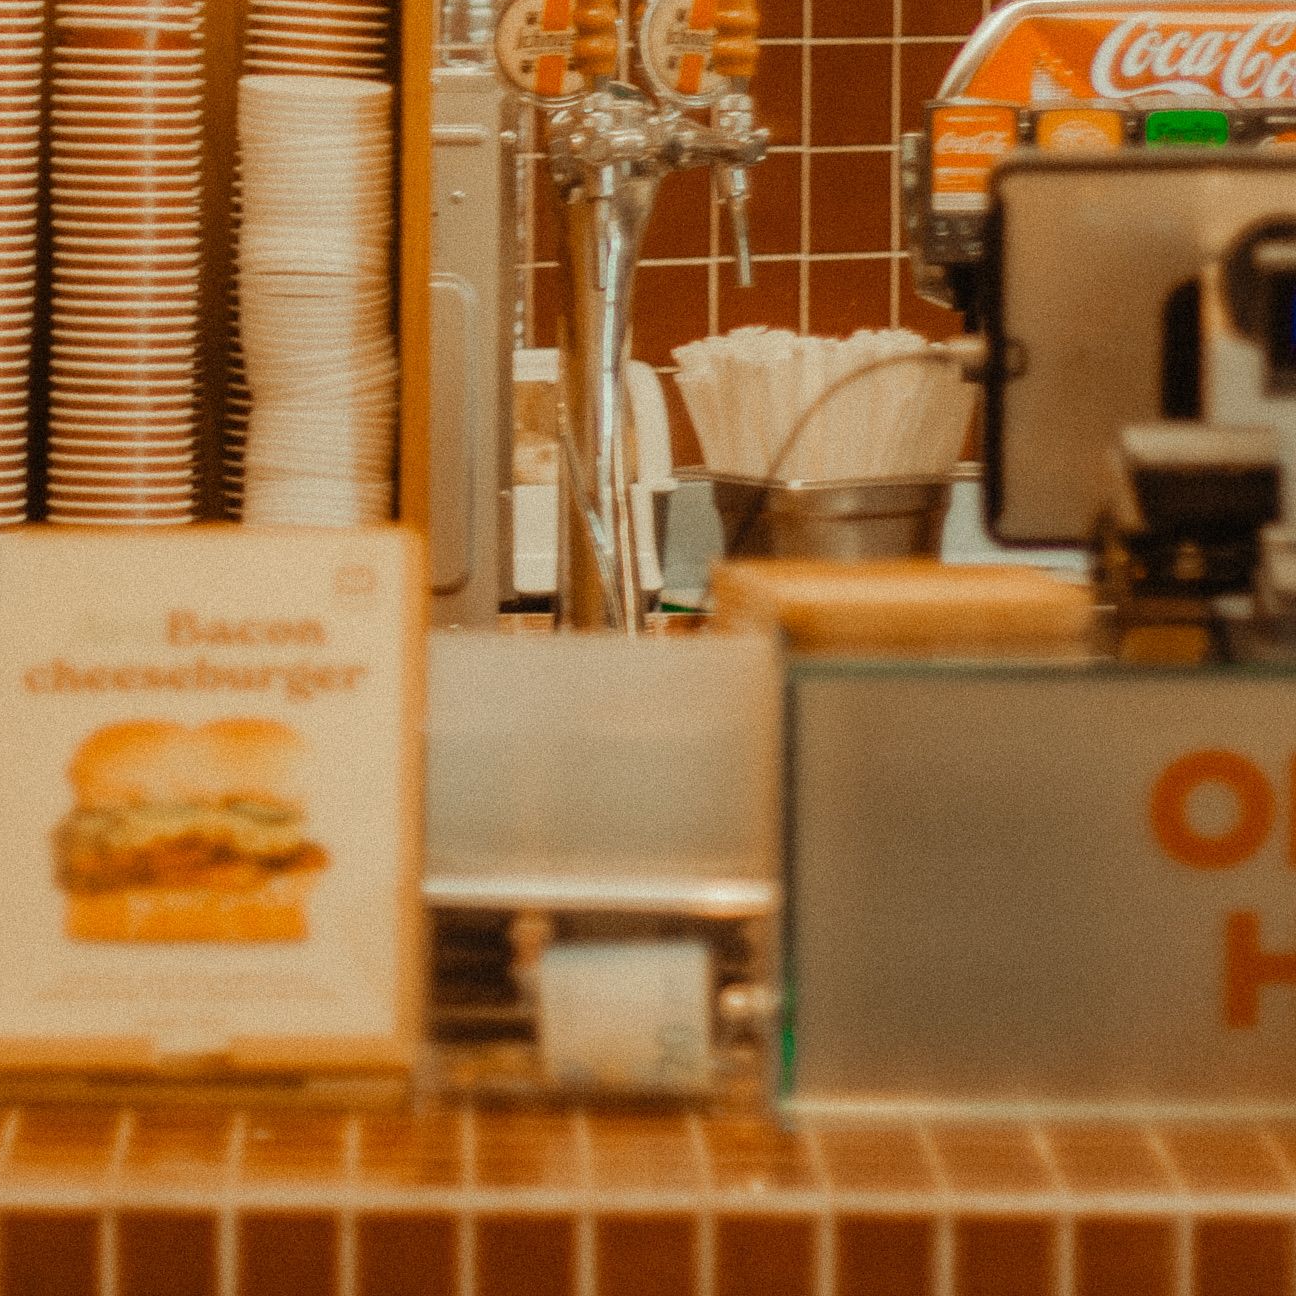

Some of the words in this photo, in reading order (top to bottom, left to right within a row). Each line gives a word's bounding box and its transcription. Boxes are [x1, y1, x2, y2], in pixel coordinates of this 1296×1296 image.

[165, 611, 328, 648] Bacon
[21, 658, 366, 702] cheeseburger
[1151, 749, 1296, 869] O
